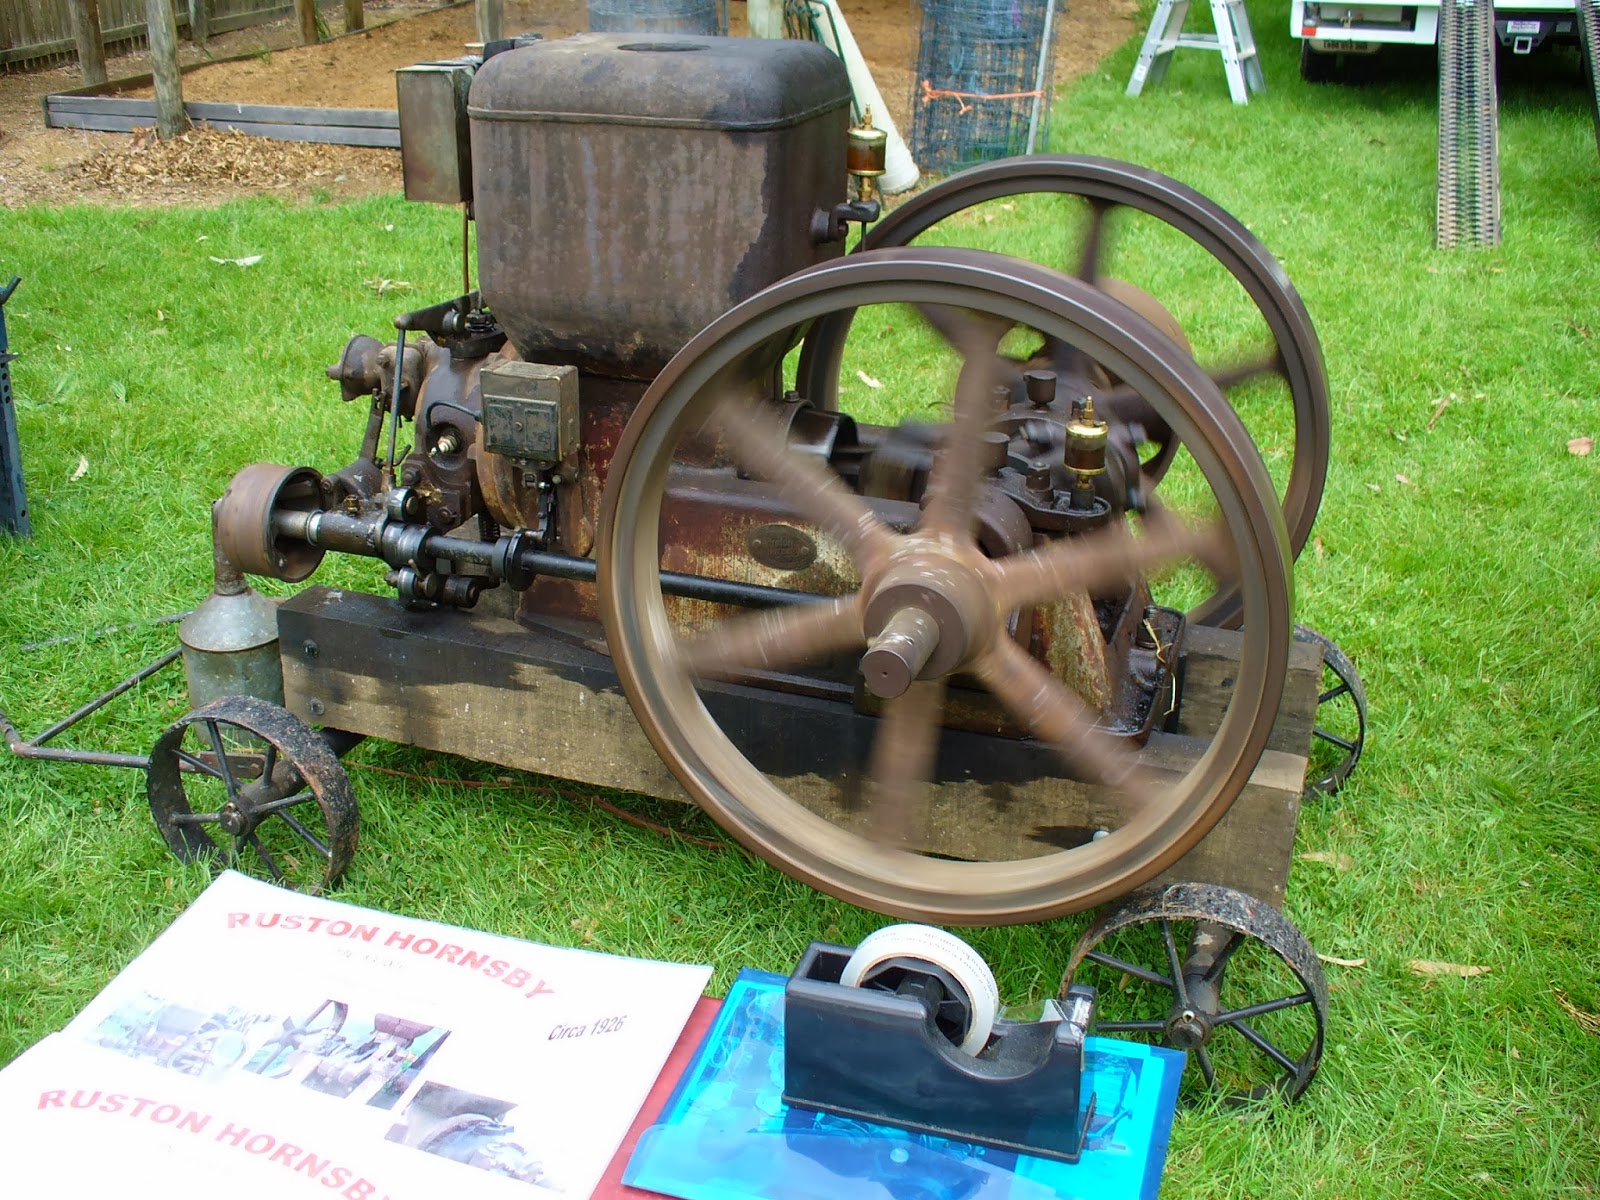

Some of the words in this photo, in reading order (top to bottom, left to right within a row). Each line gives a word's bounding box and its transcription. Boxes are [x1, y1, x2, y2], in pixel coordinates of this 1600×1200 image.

[227, 912, 381, 942] RUSTON
[384, 931, 556, 999] HORNSBY
[547, 1022, 587, 1041] Circa
[590, 1014, 628, 1036] 1926
[37, 1090, 212, 1134] RUSTON
[214, 1123, 390, 1200] HORNSB
